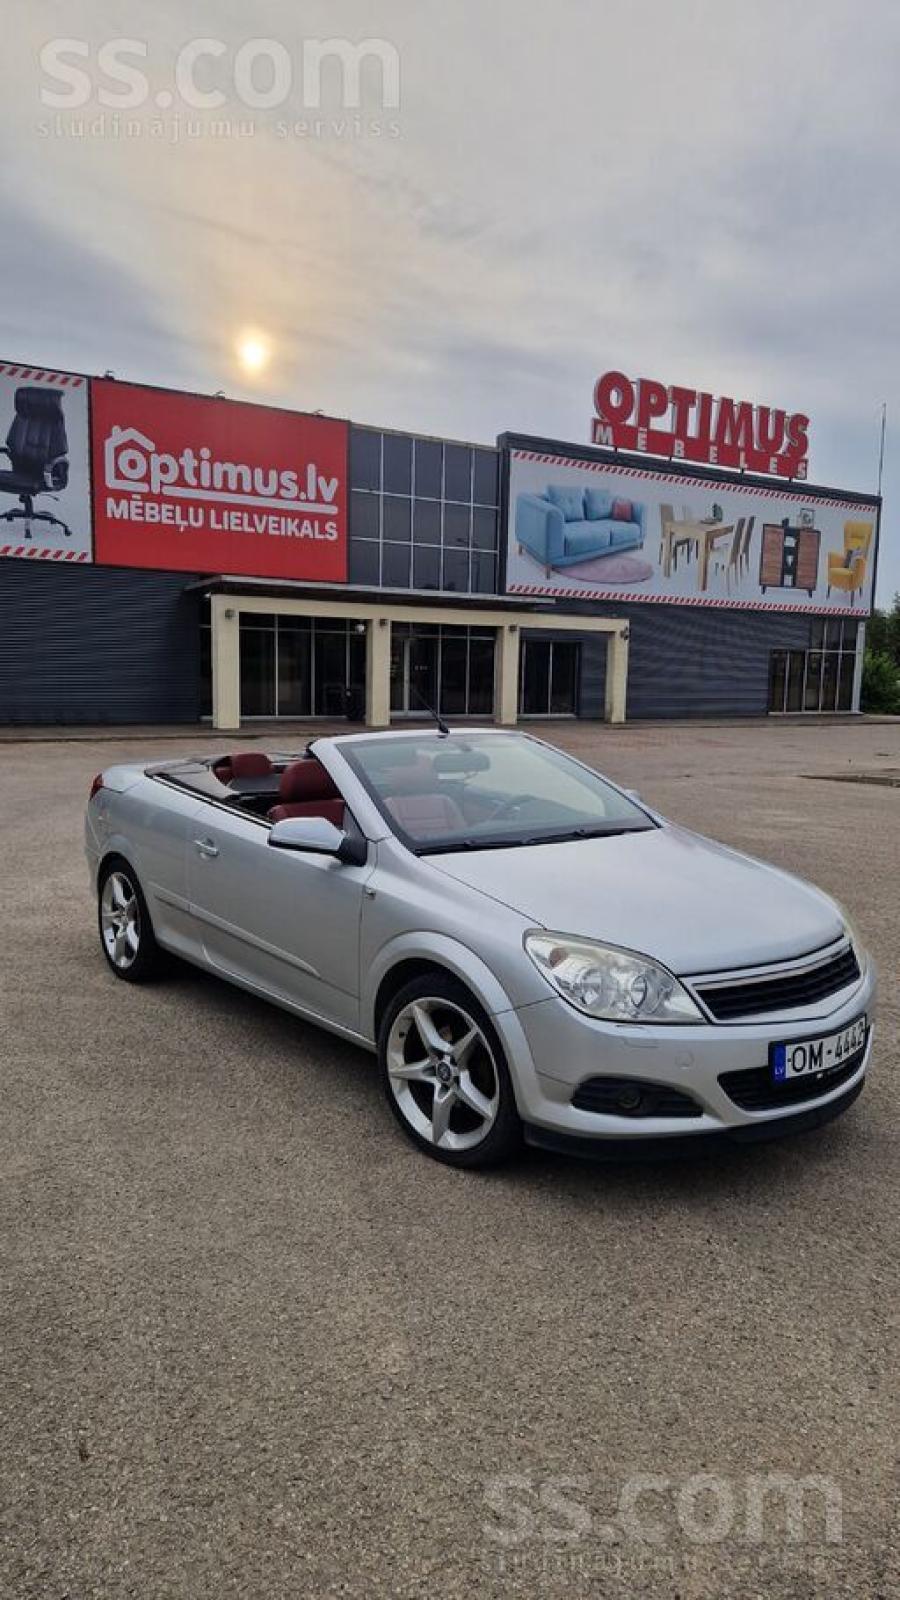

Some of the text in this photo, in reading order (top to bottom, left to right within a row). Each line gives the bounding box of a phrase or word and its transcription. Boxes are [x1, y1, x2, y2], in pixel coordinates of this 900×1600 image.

[594, 371, 810, 458] OPTIMUS
[117, 448, 338, 502] optimus.lv
[106, 495, 338, 541] MĒBEĻU LIELVEIKALS
[774, 1066, 785, 1076] LV
[792, 1021, 864, 1073] OM-4442
